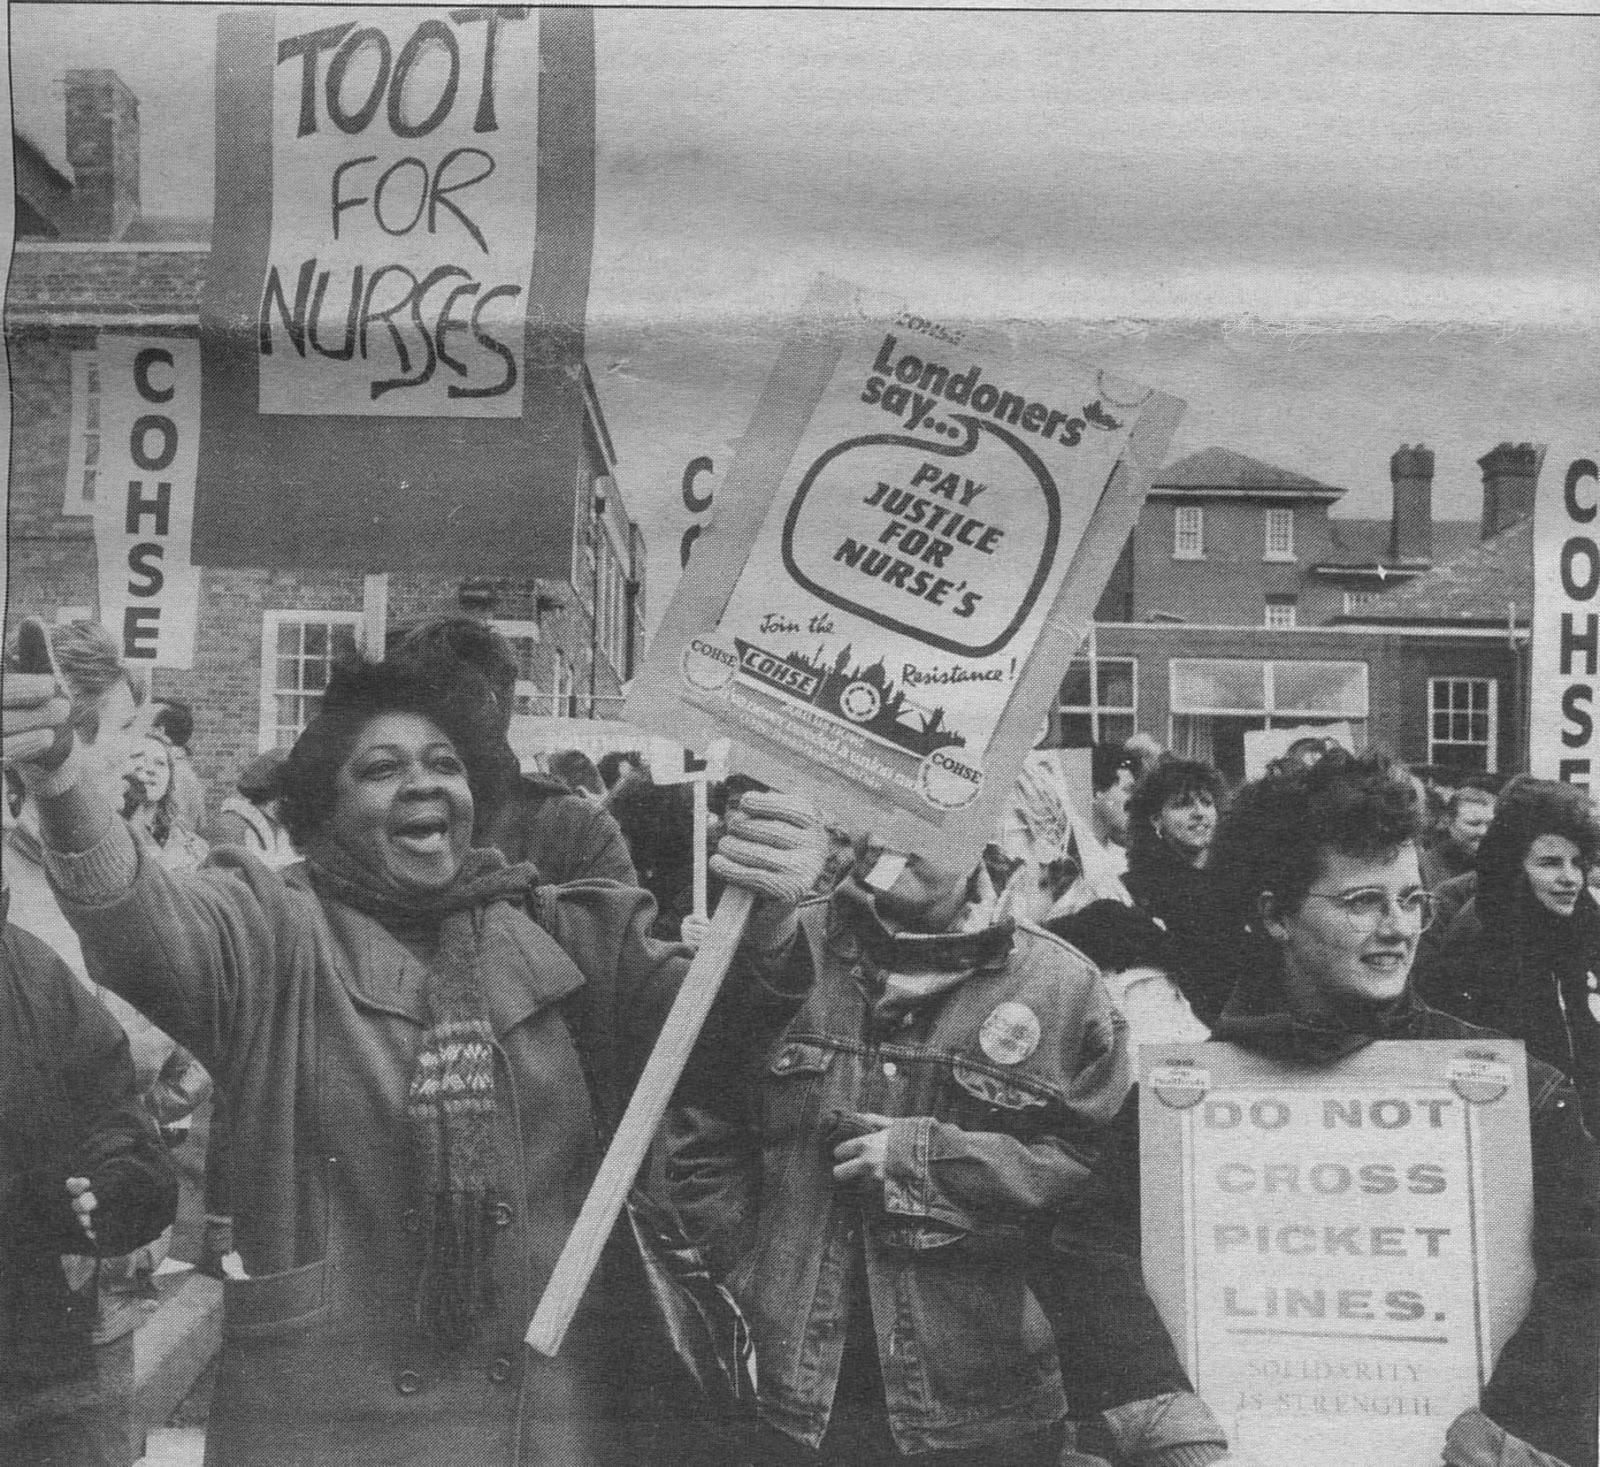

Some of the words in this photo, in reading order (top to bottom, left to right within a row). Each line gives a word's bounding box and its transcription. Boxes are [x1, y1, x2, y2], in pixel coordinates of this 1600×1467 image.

[277, 6, 531, 138] TOOT
[332, 147, 496, 254] FOR
[259, 258, 523, 401] NURSES
[860, 376, 960, 439] say...
[872, 334, 1087, 447] Londoners
[122, 347, 179, 661] COHSE
[909, 462, 987, 507] PAY
[863, 481, 1005, 555] JUSTICE
[878, 519, 954, 569] FOR
[832, 537, 984, 618] NURSE'S
[759, 612, 801, 634] Join
[808, 612, 836, 634] the
[690, 638, 739, 668] COHSE
[744, 651, 818, 694] COHSE
[931, 752, 984, 786] COHSE
[1202, 1099, 1291, 1130] DO
[1322, 1099, 1454, 1130] NOT
[1215, 1162, 1448, 1195] CROSS
[1212, 1223, 1451, 1258] PICKET
[1222, 1287, 1447, 1322] LINES.
[1237, 1391, 1263, 1411] IS
[1277, 1392, 1432, 1417] STRENGTH
